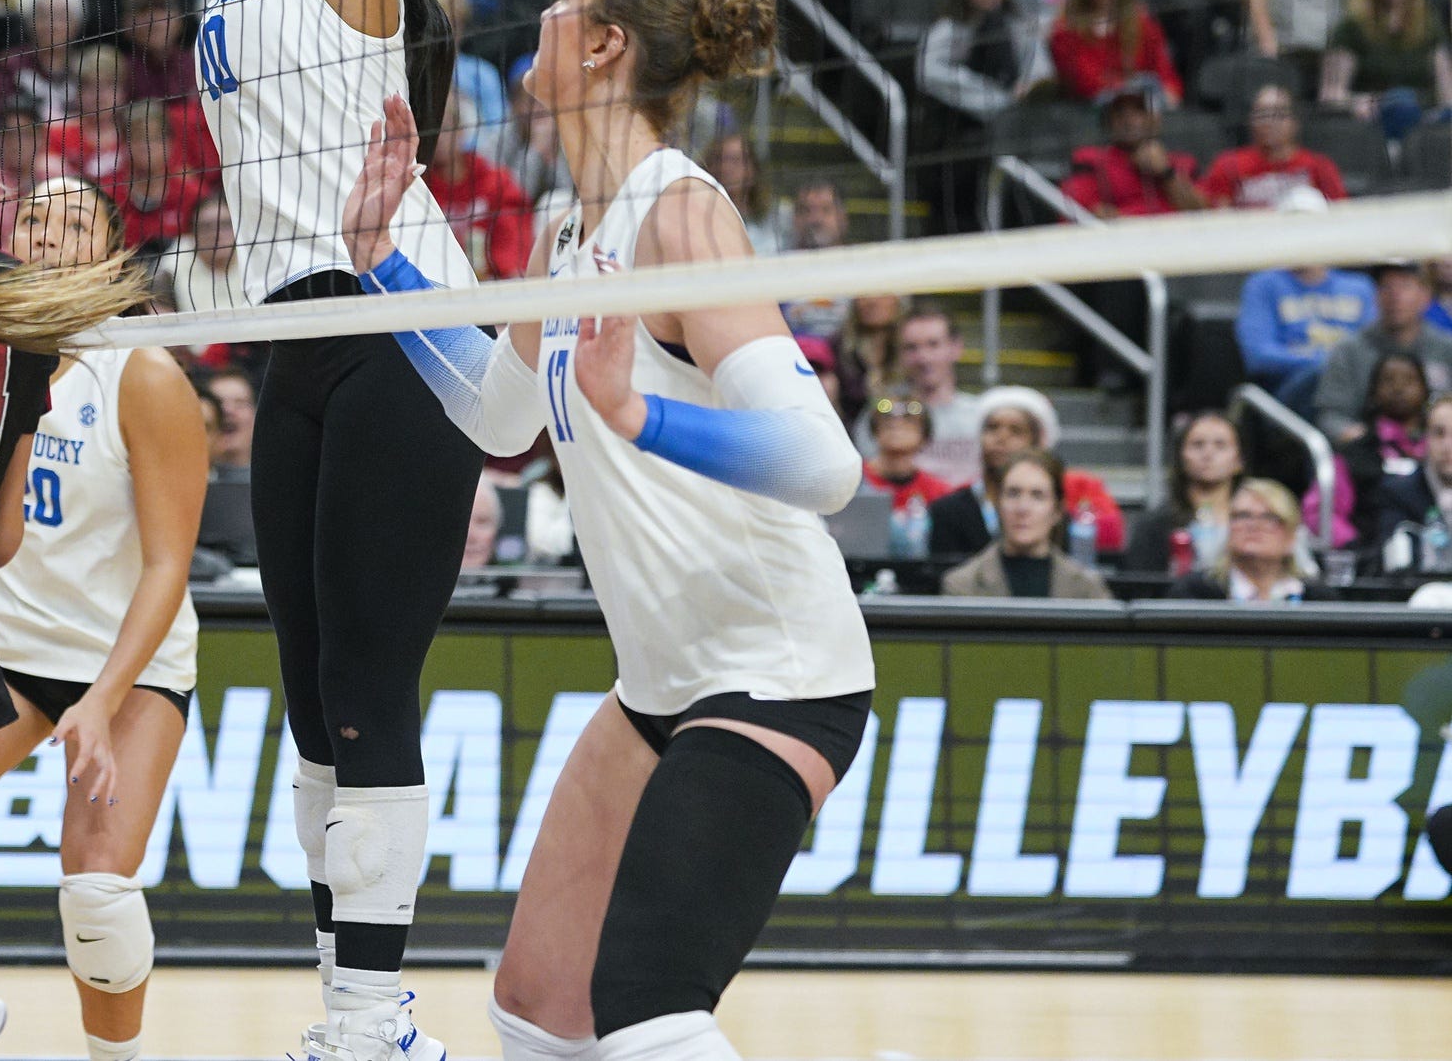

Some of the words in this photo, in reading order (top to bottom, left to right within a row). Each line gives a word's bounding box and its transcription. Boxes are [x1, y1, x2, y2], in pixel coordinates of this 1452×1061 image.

[198, 14, 240, 101] 10
[548, 350, 574, 442] 17
[34, 432, 84, 465] UCKY
[24, 467, 63, 527] 0
